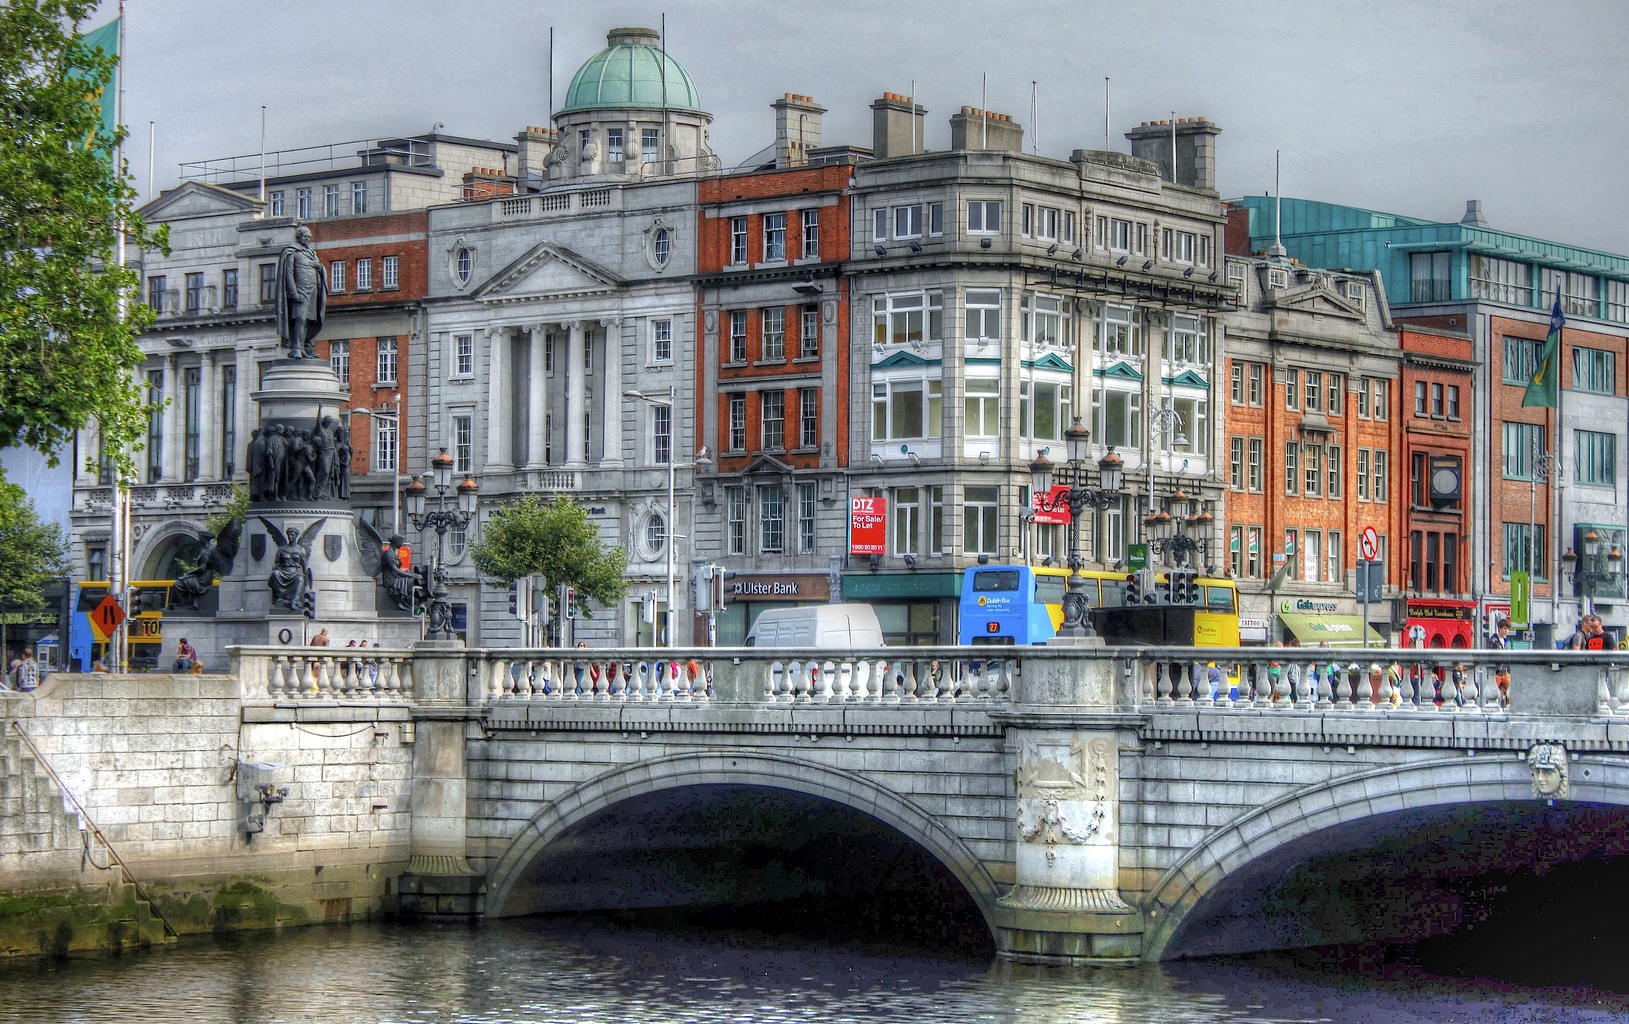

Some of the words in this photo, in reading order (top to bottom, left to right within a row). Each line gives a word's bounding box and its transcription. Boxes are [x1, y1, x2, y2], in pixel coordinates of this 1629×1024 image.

[852, 499, 874, 510] DTZ
[866, 515, 884, 523] Sale/
[743, 582, 772, 594] Ulster
[773, 581, 798, 594] Bank
[989, 623, 998, 632] 27
